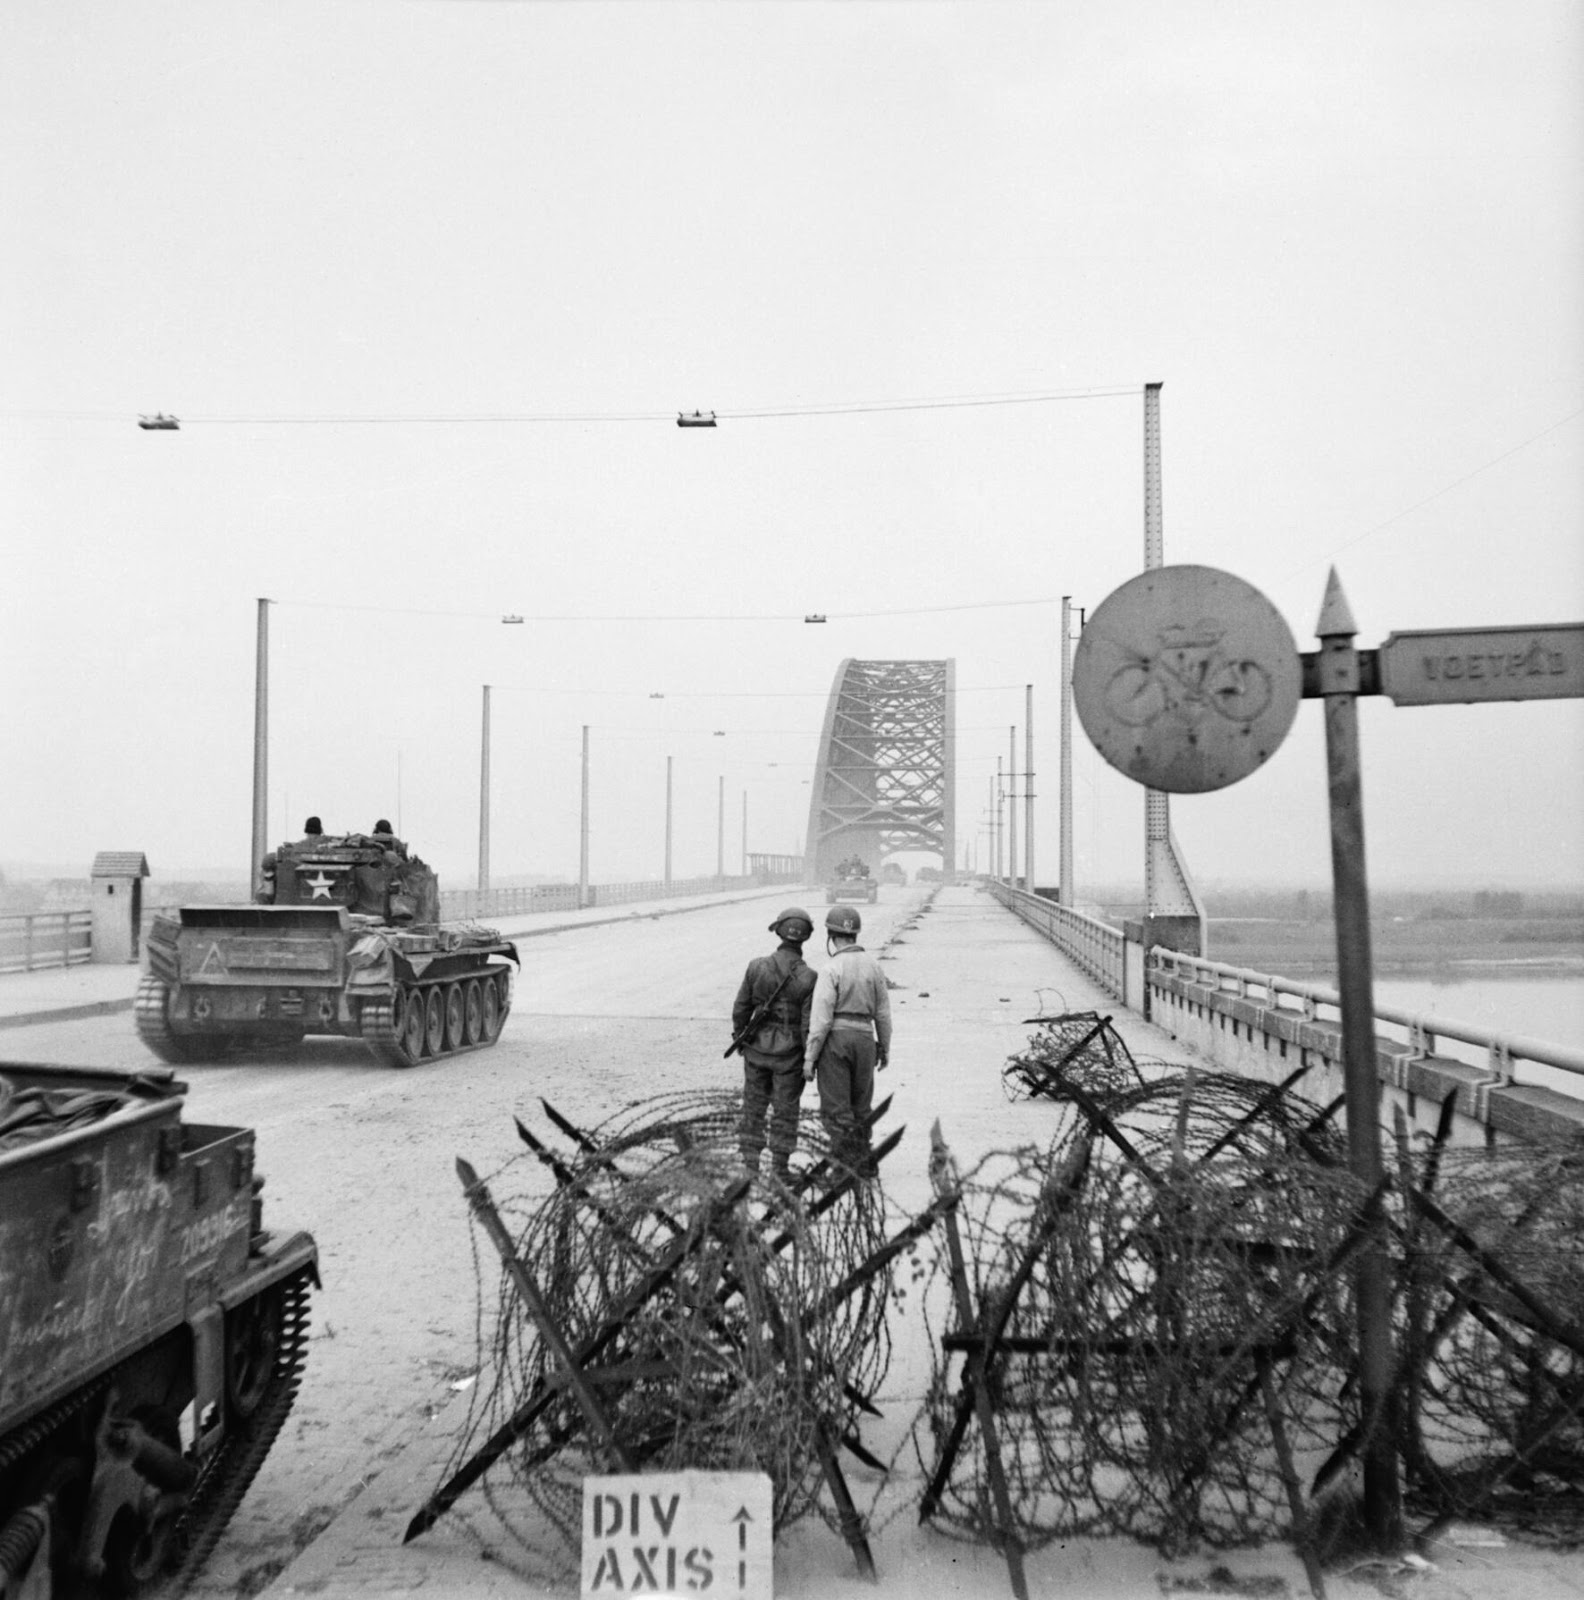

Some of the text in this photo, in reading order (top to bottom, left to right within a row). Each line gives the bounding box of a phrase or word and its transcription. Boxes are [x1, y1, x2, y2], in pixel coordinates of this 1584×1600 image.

[1422, 640, 1567, 681] VOETPAD
[593, 1493, 680, 1538] DIV
[591, 1547, 714, 1591] AXIS
